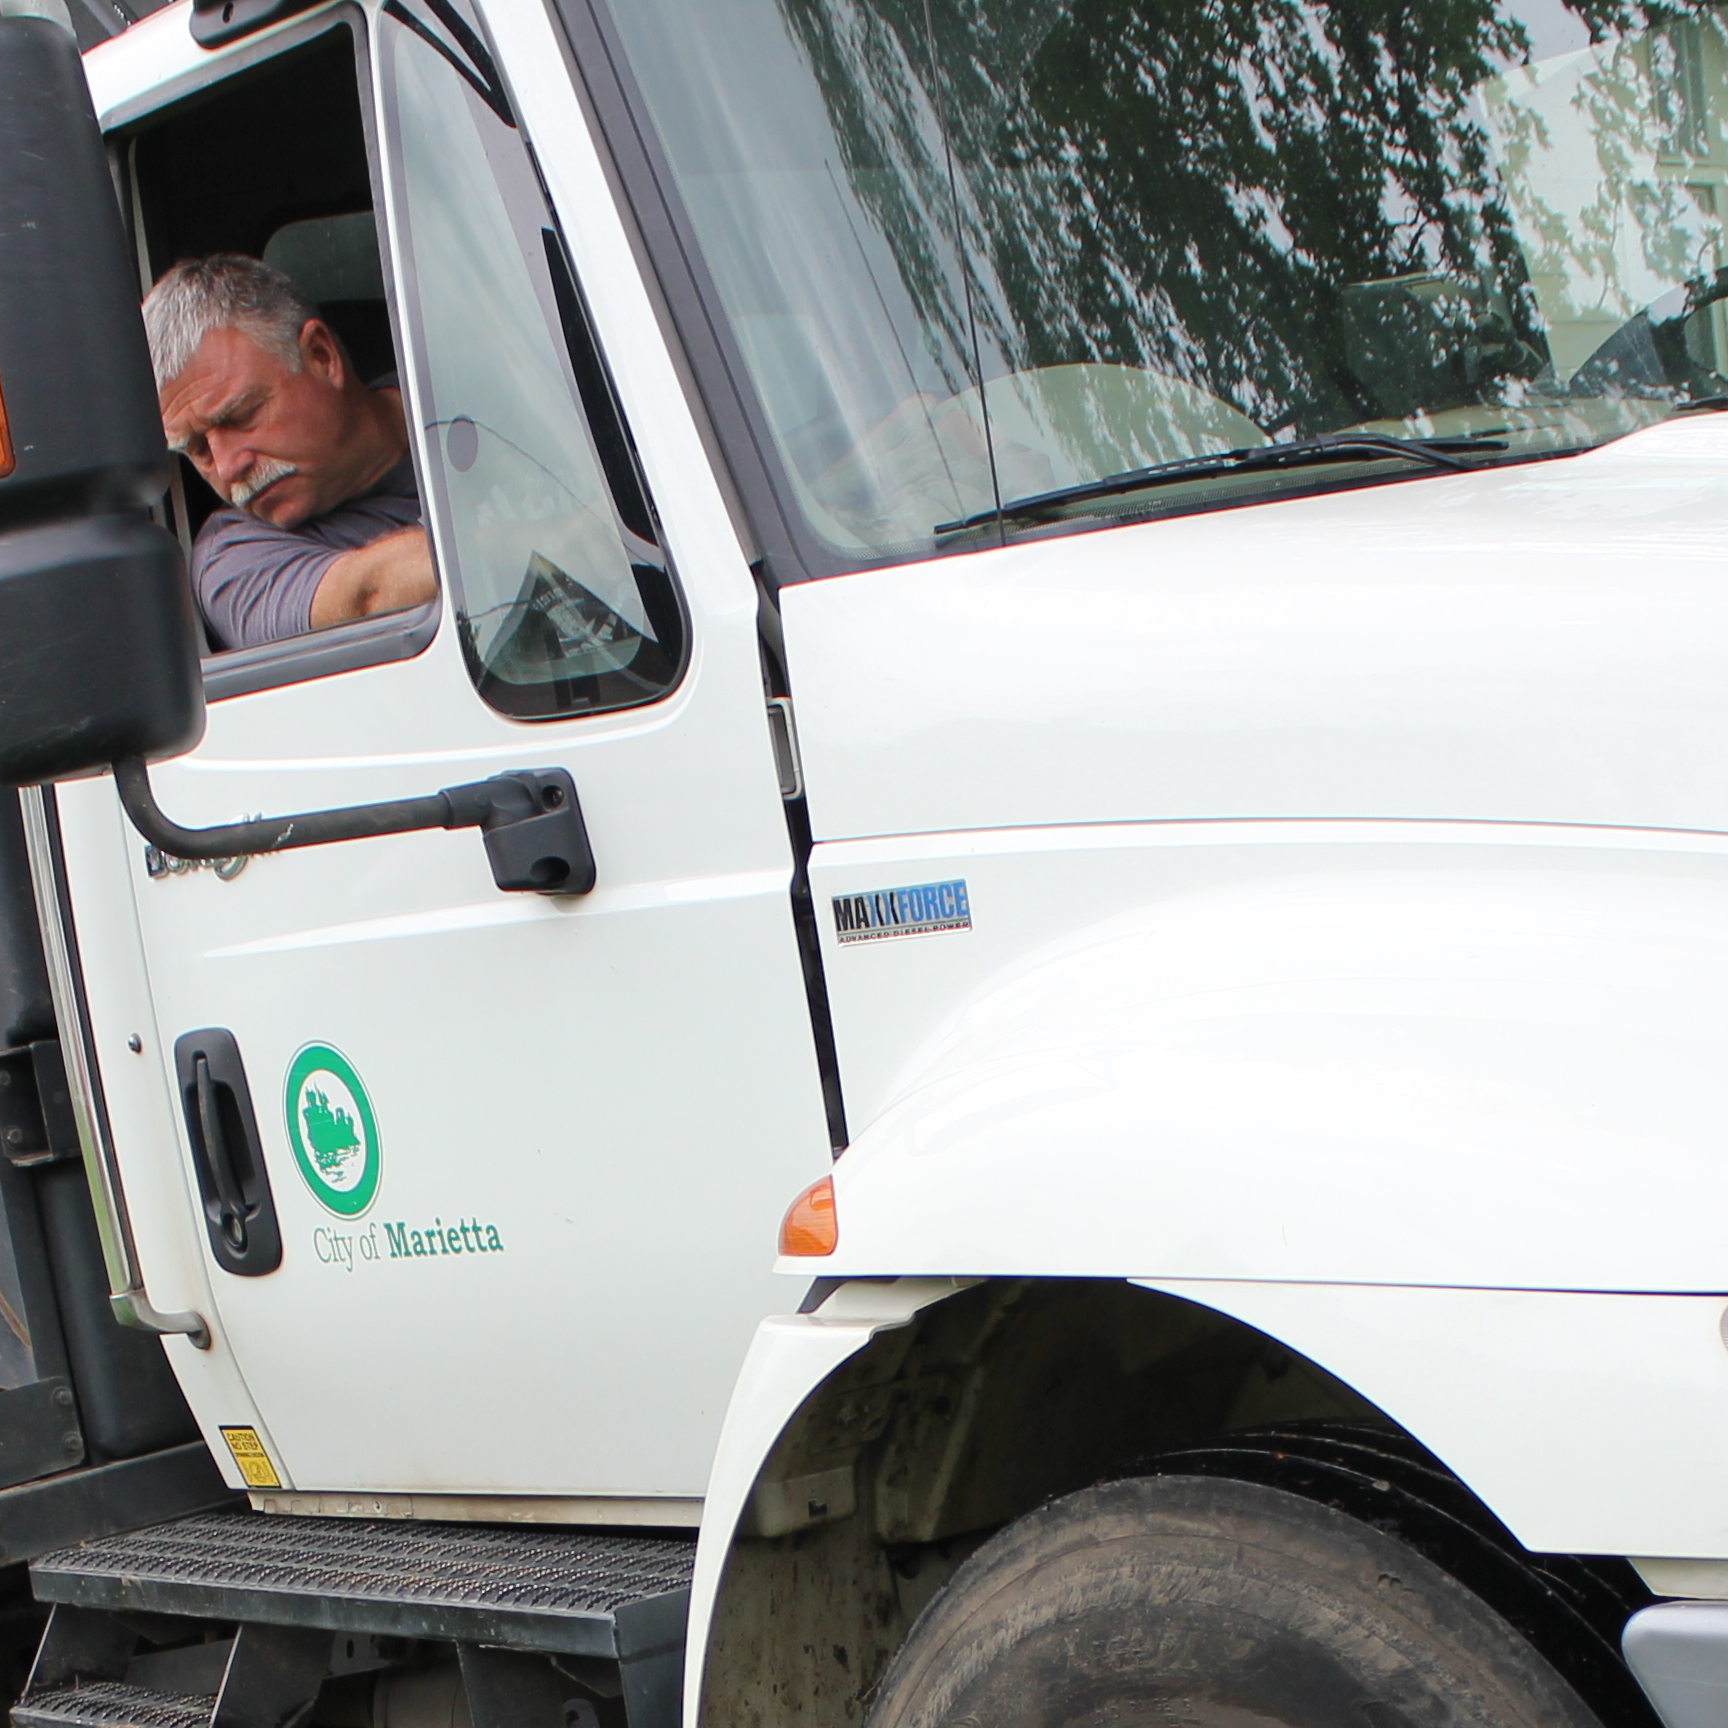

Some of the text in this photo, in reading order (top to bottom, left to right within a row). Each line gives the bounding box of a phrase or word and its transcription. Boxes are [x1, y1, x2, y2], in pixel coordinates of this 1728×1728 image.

[832, 881, 969, 931] MAXXFORCE
[839, 921, 970, 944] ADVANCED DIESEL POWER
[313, 1217, 505, 1273] City of Marietta
